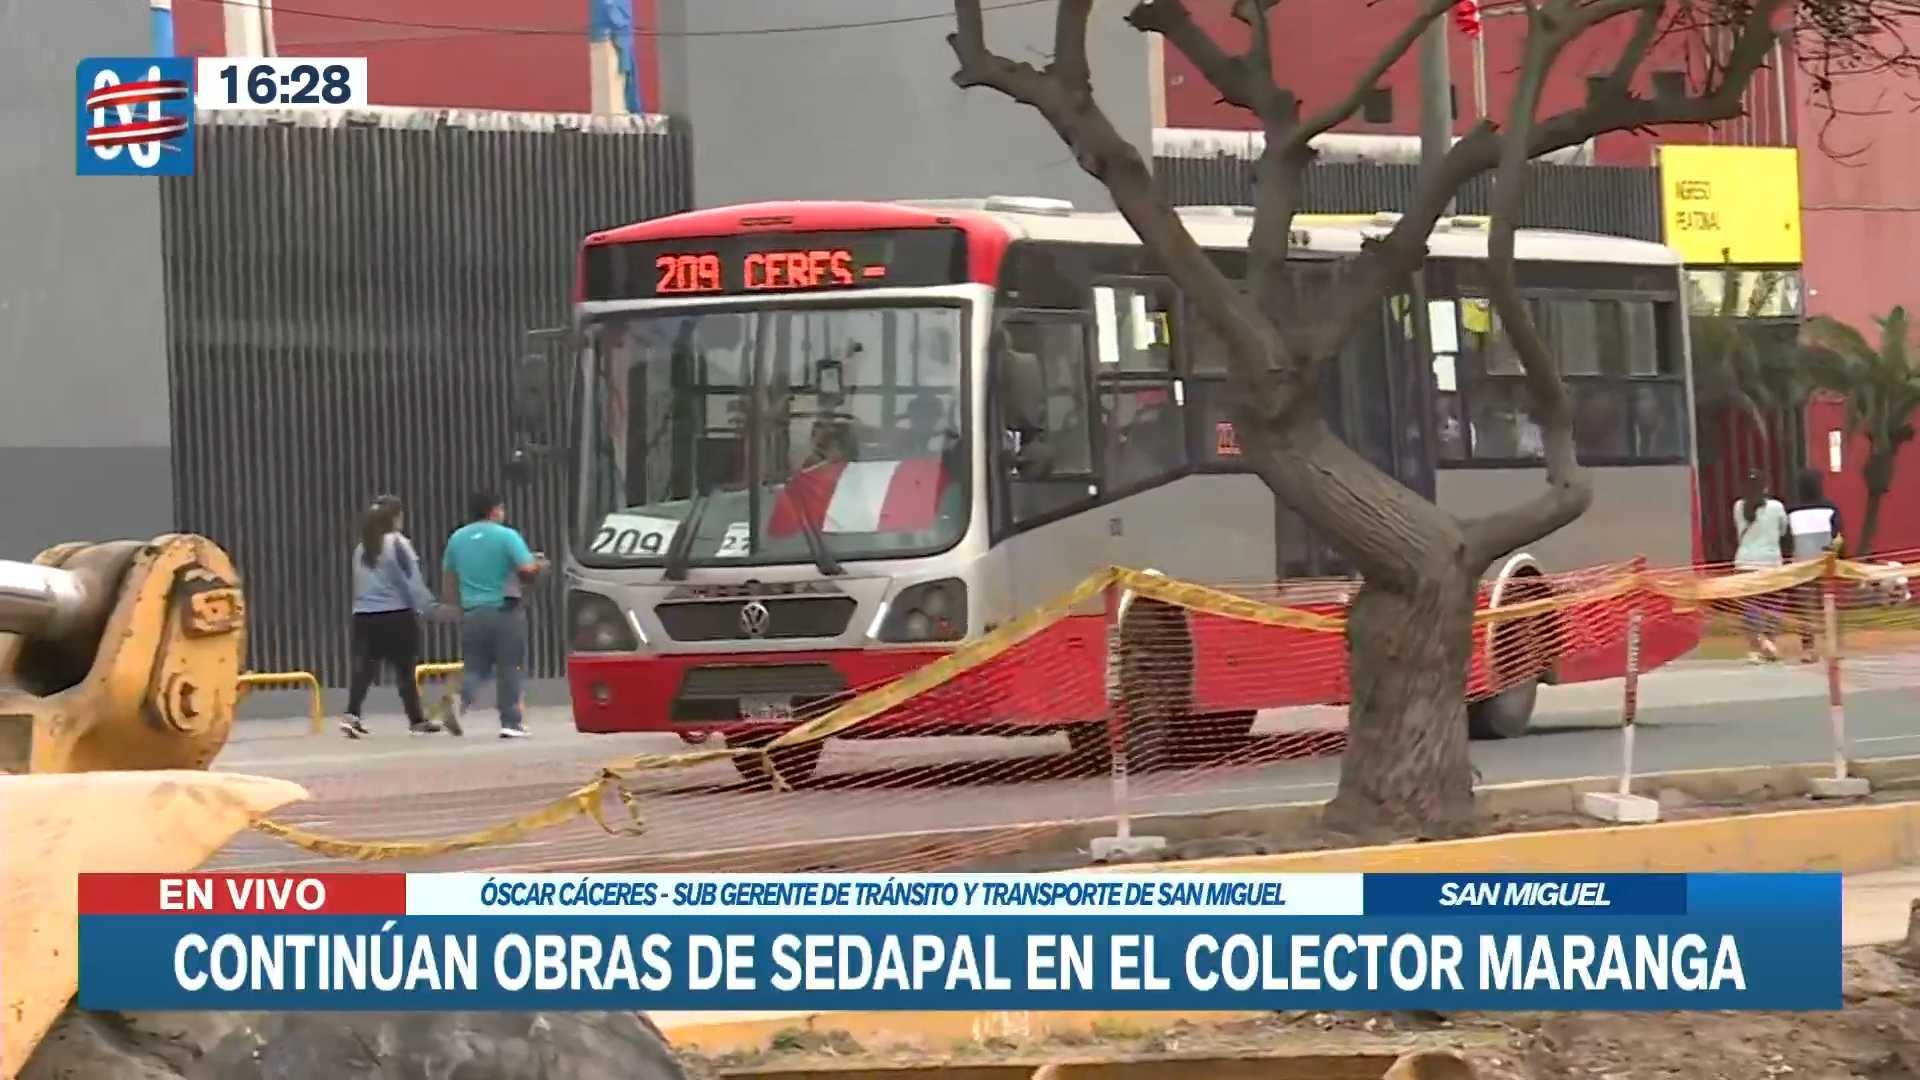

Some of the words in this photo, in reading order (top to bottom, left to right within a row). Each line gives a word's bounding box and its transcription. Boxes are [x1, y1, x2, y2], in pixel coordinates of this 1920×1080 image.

[656, 254, 722, 292] 209
[744, 250, 852, 289] CERES
[592, 526, 663, 553] 209
